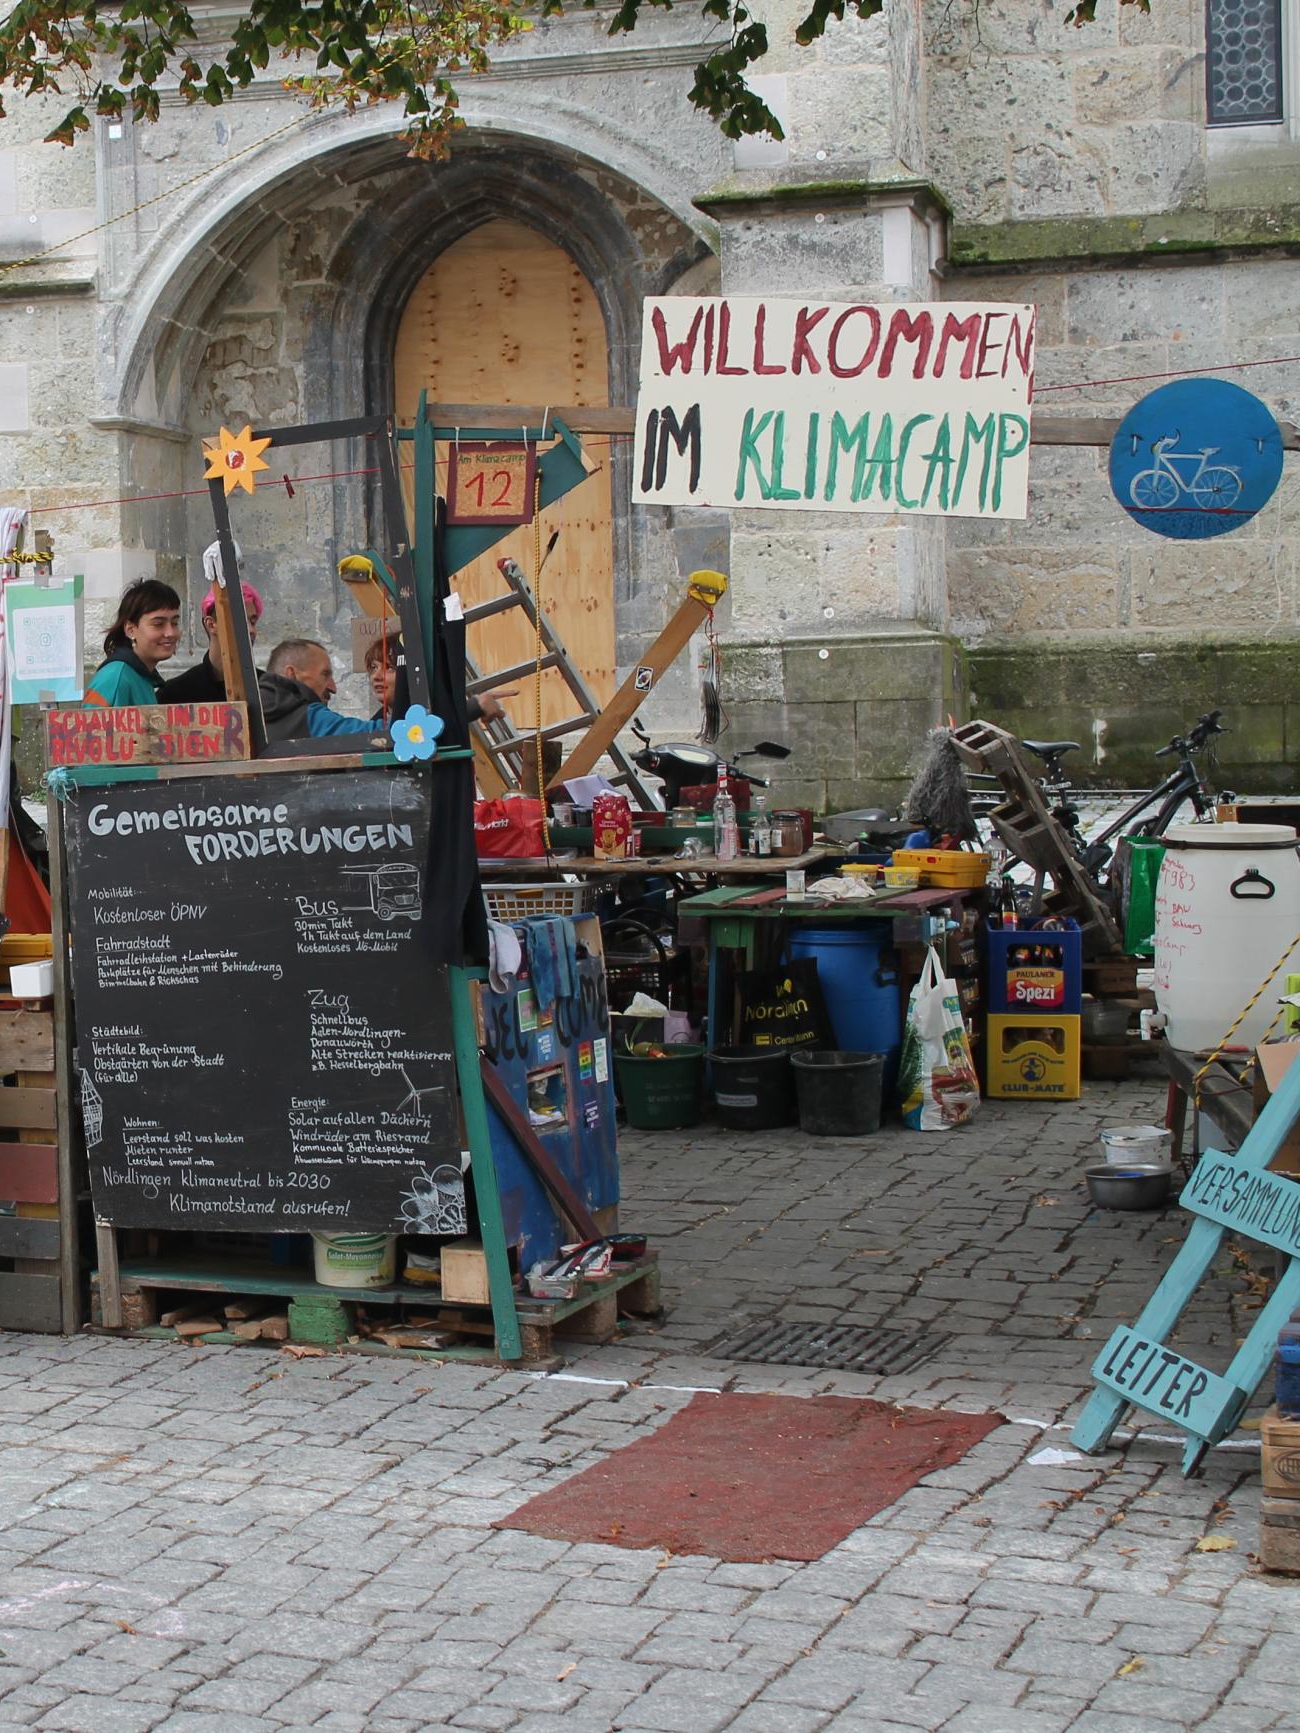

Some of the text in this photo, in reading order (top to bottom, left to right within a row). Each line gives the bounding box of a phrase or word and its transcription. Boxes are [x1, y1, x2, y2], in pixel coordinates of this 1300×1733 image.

[651, 301, 1036, 385] WILLKOMMEN
[476, 453, 526, 464] Klimacamp
[640, 403, 1030, 512] IM KLIMACAMP
[465, 471, 512, 507] 12
[48, 708, 146, 735] SCHAUKEL
[88, 803, 288, 836] Gemeinsame
[185, 823, 413, 865] FORDERUNGEN
[94, 902, 207, 924] Kostenloser ÖPNV
[296, 896, 339, 916] Bus
[294, 918, 353, 931] 30min Takt
[95, 935, 171, 952] Fahrradstadt
[302, 929, 412, 941] 1h Takt auf dem Land
[297, 943, 350, 953] Kostenloses
[97, 953, 177, 967] Fahrradleihstation
[98, 962, 283, 980] Parkplätze für Menschen mit Behinderung
[1015, 980, 1055, 1002] Spezi
[308, 989, 350, 1015] Zug
[310, 1013, 369, 1026] Schnellbus
[92, 1042, 198, 1061] Vertikale Begrünung
[311, 1050, 452, 1061] Alte Strecken reaktivieren
[93, 1054, 225, 1073] Obstgärten von der Stadt
[330, 1060, 404, 1076] Hesselbergbahn
[288, 1111, 431, 1128] Solar auf allen Dächern
[122, 1132, 244, 1144] Leerstand soll was kosten
[289, 1128, 431, 1144] Windräder am Riesrand
[125, 1144, 194, 1155] Mieten runter
[293, 1142, 415, 1155] Kommunale Batteriespeicher
[127, 1156, 164, 1167] Leerstand
[102, 1166, 331, 1199] Nördlingen klimaneutral bis 2030
[169, 1193, 350, 1216] Klimanotstand ausrufen!
[1190, 1160, 1300, 1249] VERSAMMLUN
[1102, 1335, 1208, 1418] LEITER
